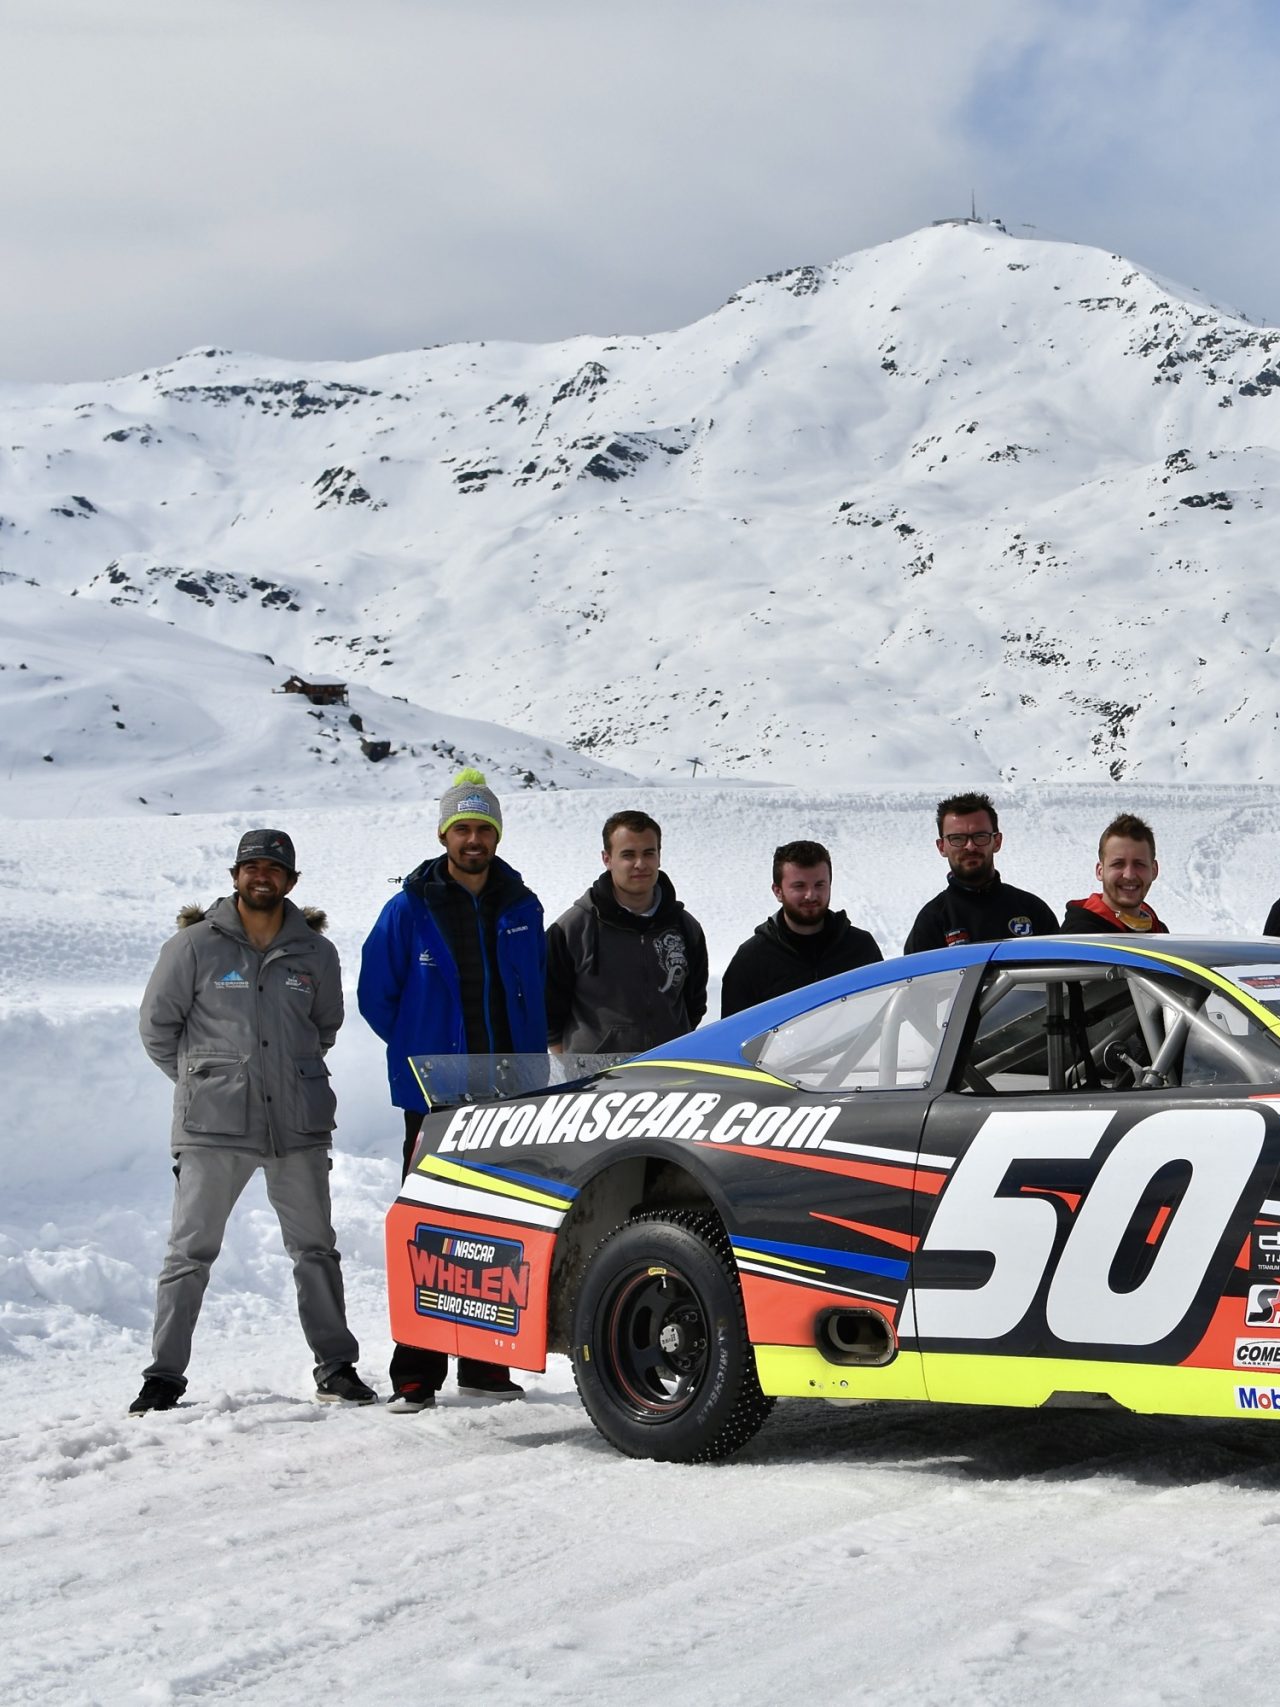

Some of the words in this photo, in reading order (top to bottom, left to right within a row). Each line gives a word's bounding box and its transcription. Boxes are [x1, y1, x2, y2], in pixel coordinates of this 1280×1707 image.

[437, 1092, 842, 1153] EuroNASCAR.com
[454, 1240, 495, 1263] NASCAR
[896, 1109, 1266, 1345] 50
[408, 1243, 529, 1308] WHELEN
[437, 1295, 462, 1315] EURO
[463, 1299, 498, 1322] SERIES
